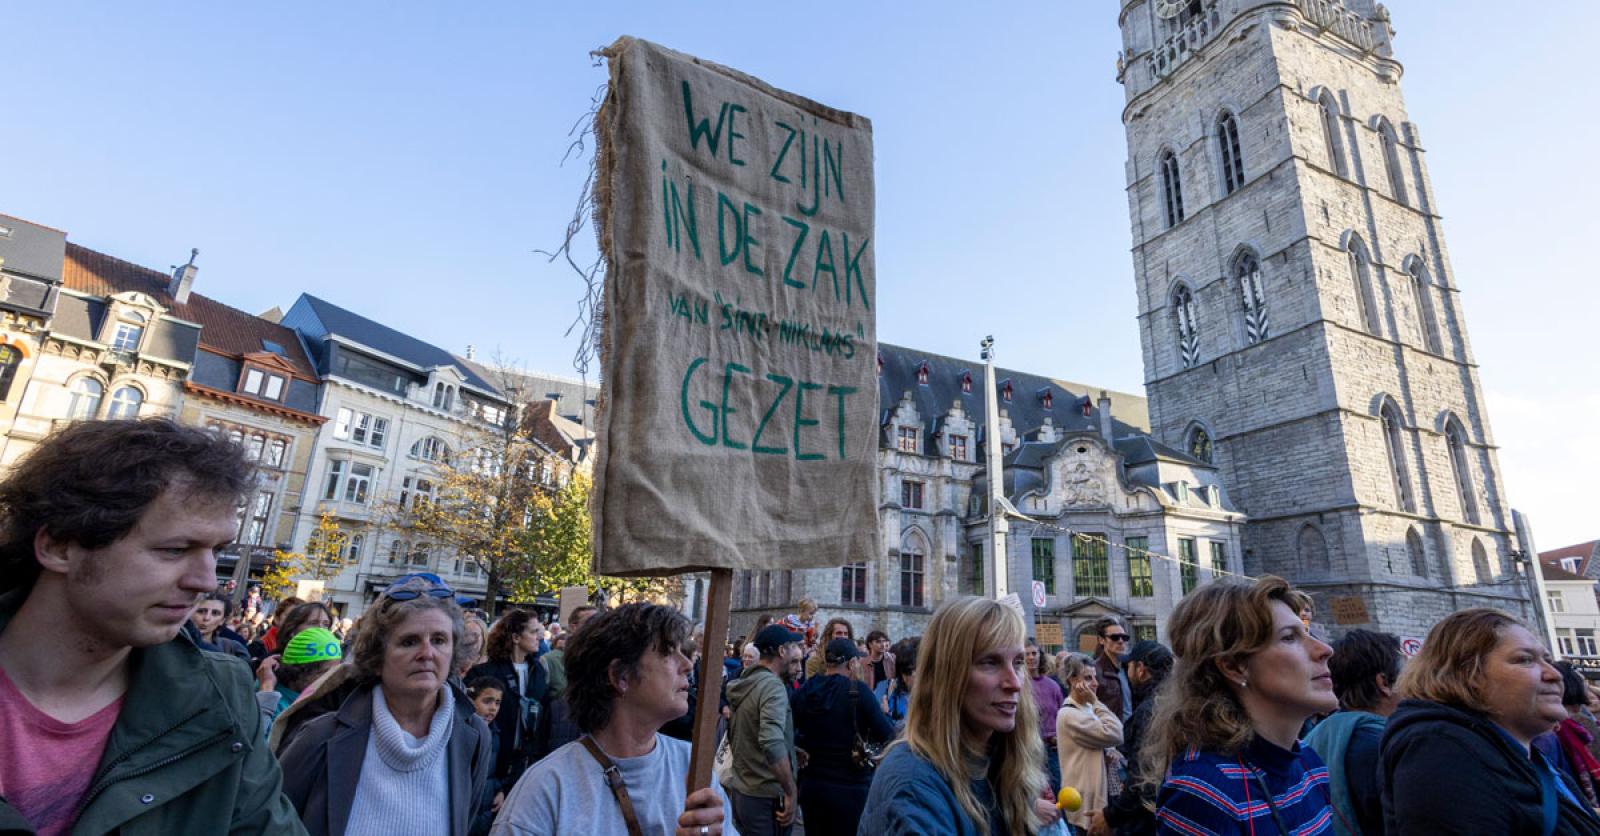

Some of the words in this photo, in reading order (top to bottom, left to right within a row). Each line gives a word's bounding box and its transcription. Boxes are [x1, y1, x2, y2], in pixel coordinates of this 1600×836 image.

[682, 80, 748, 167] WE
[717, 192, 764, 277] DE
[781, 215, 870, 309] ZAK
[669, 291, 710, 325] VAN
[681, 357, 857, 461] GEZET
